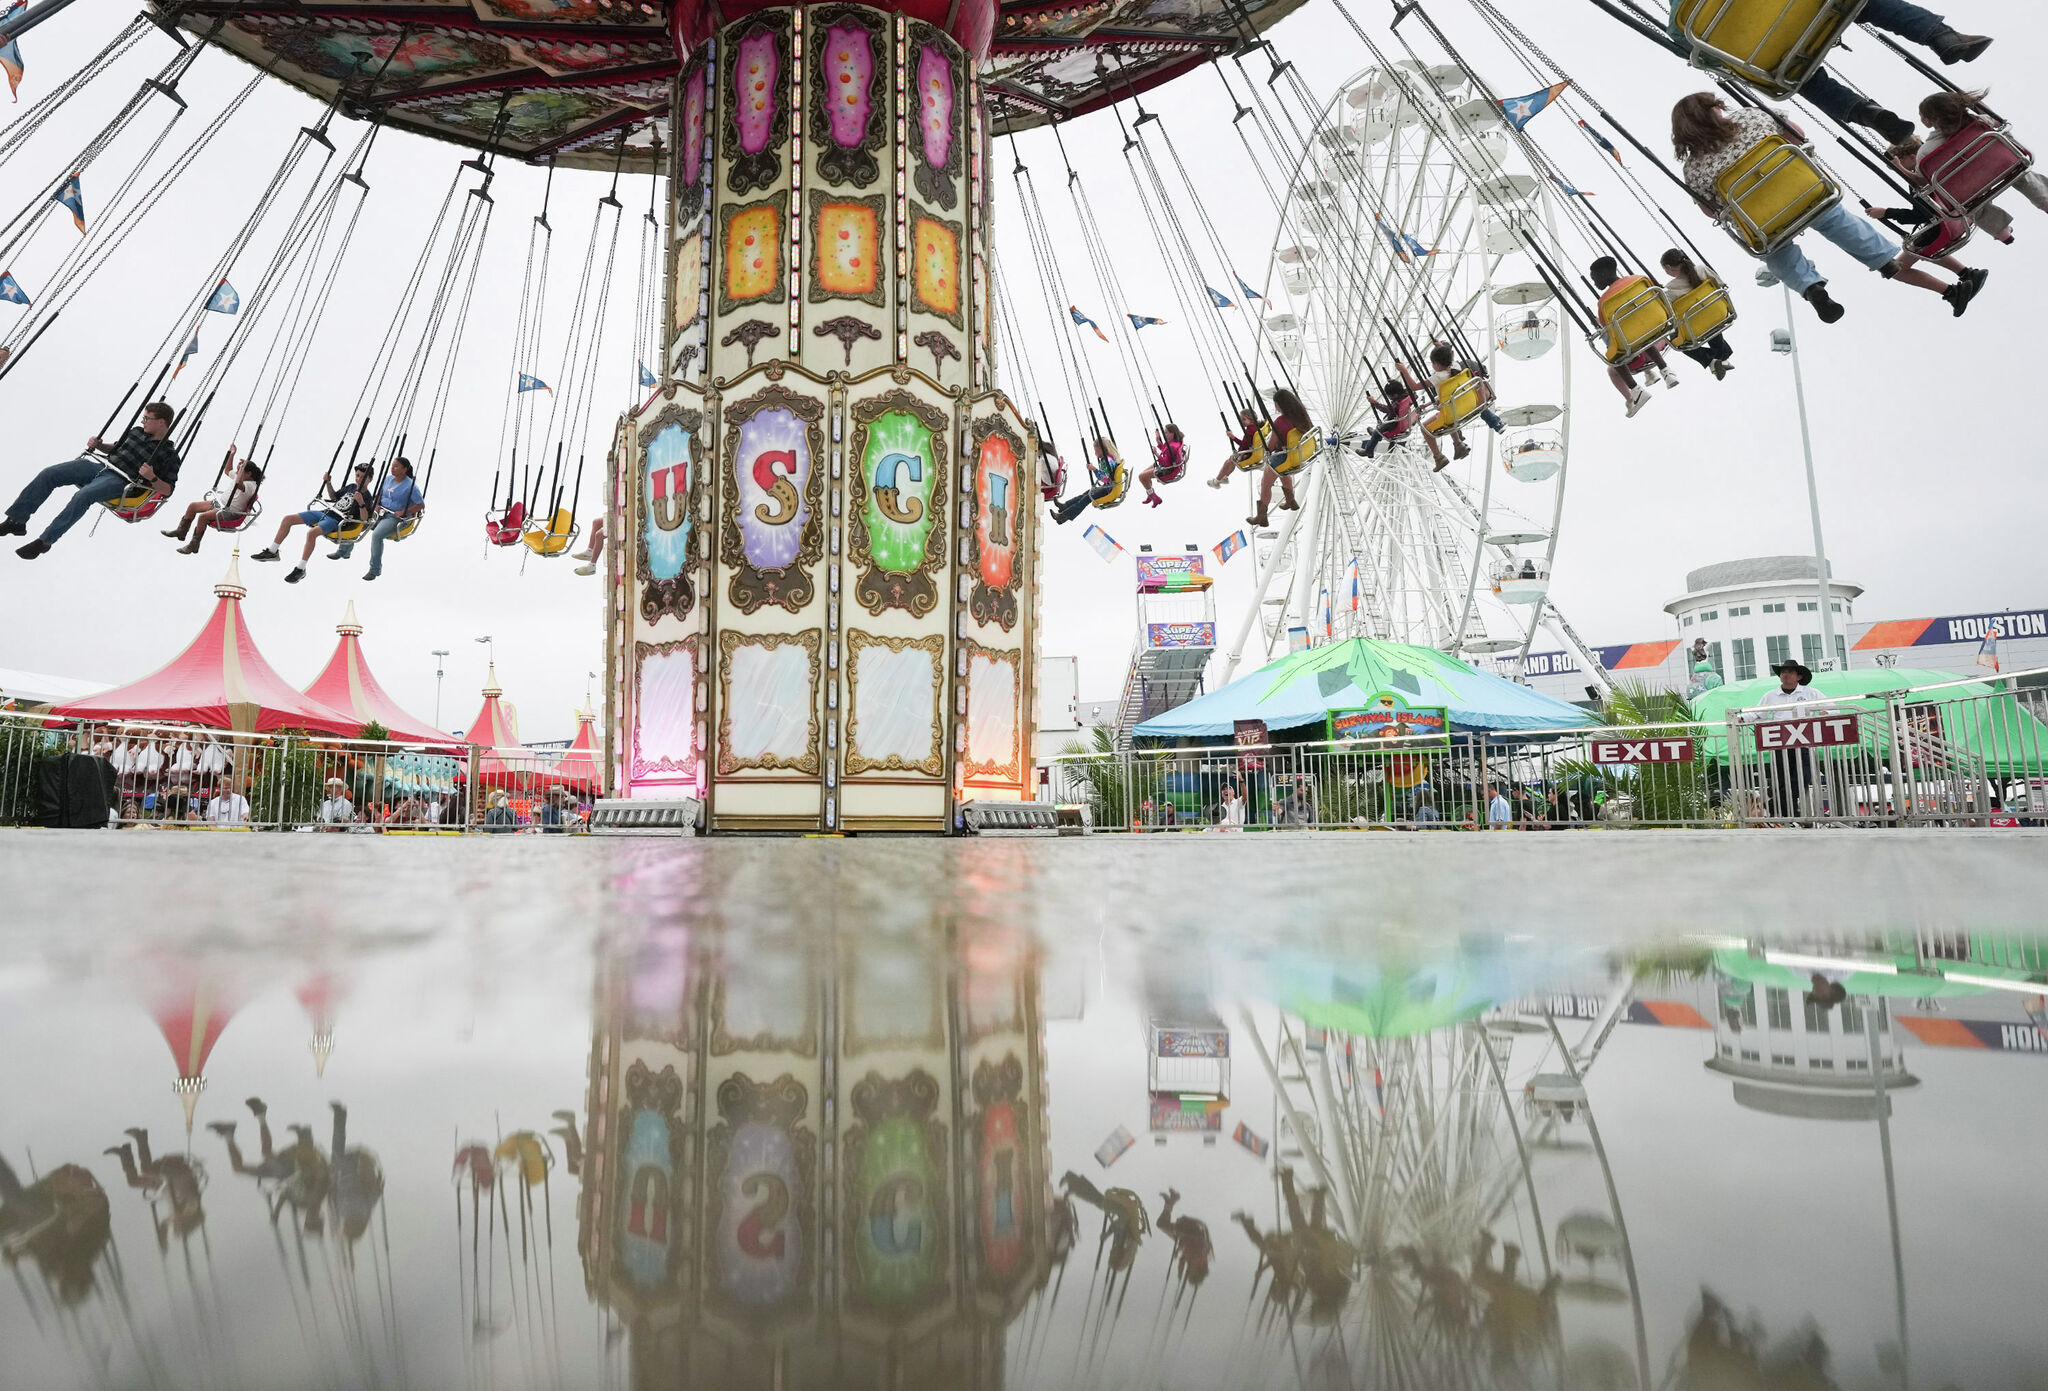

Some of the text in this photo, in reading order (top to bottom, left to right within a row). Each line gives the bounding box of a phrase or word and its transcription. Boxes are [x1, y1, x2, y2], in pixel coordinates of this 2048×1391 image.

[650, 461, 688, 531] U
[752, 449, 800, 526] S
[1948, 613, 2047, 640] HOUSTON
[1334, 712, 1442, 730] SURVIVAL ISLAND
[1238, 734, 1260, 746] VIP
[1761, 719, 1851, 748] EXIT
[1598, 741, 1687, 762] EXIT
